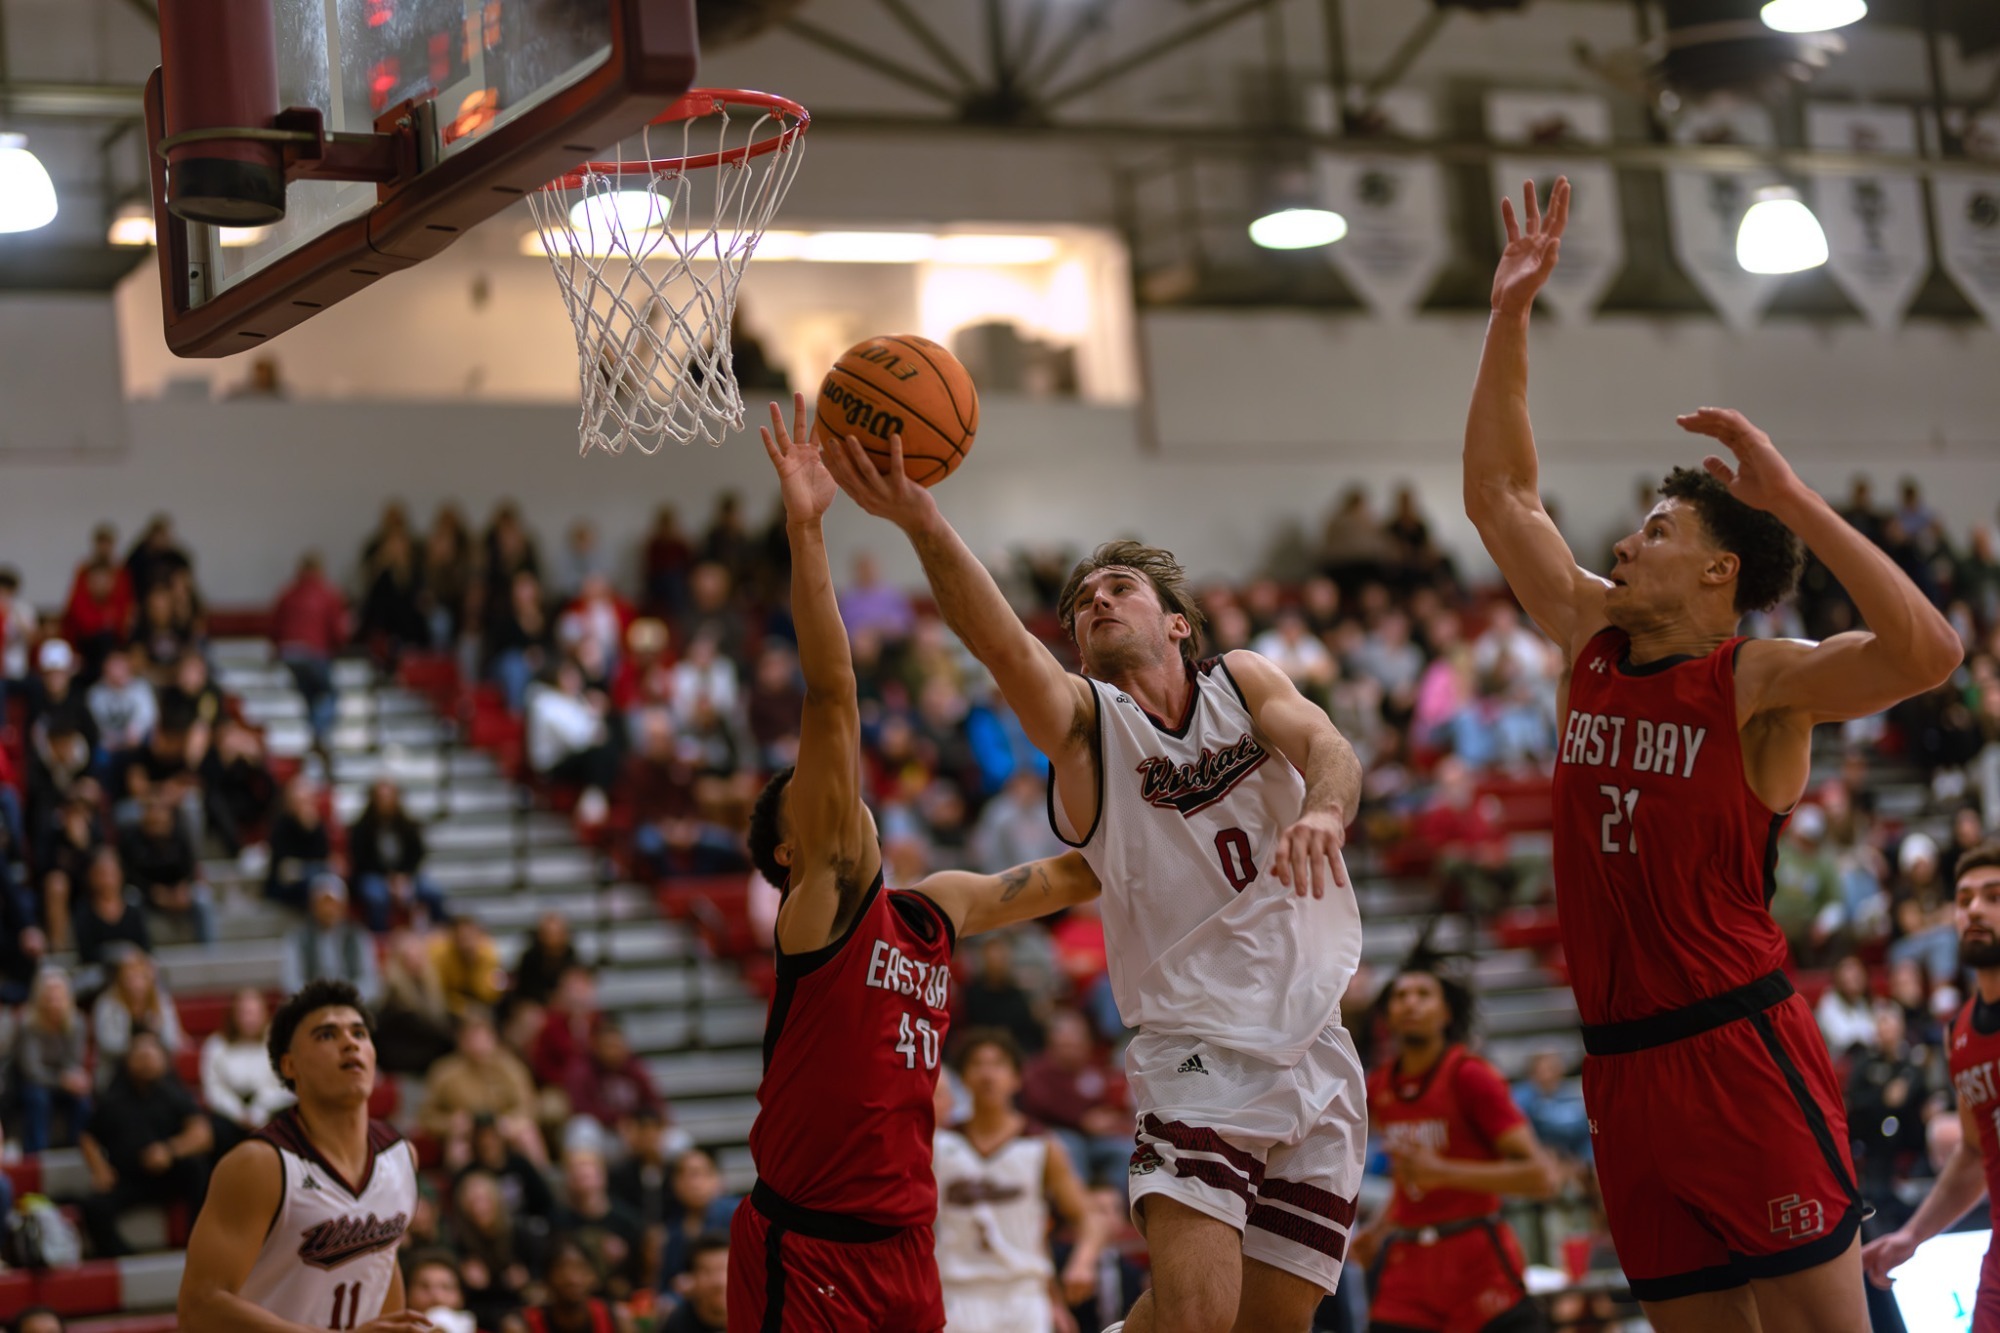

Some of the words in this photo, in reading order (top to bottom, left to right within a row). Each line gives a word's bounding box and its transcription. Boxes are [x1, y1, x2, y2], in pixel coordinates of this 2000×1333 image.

[860, 345, 919, 381] EVO
[823, 377, 904, 441] Wilson
[1562, 709, 1626, 768] EAST
[1632, 718, 1707, 779] BAY
[1599, 784, 1640, 855] 21
[1213, 827, 1258, 893] 0
[865, 939, 930, 1001] EAST
[924, 964, 950, 1010] BA
[895, 1011, 939, 1070] 40
[1767, 1193, 1824, 1239] EB
[328, 1281, 362, 1331] 11
